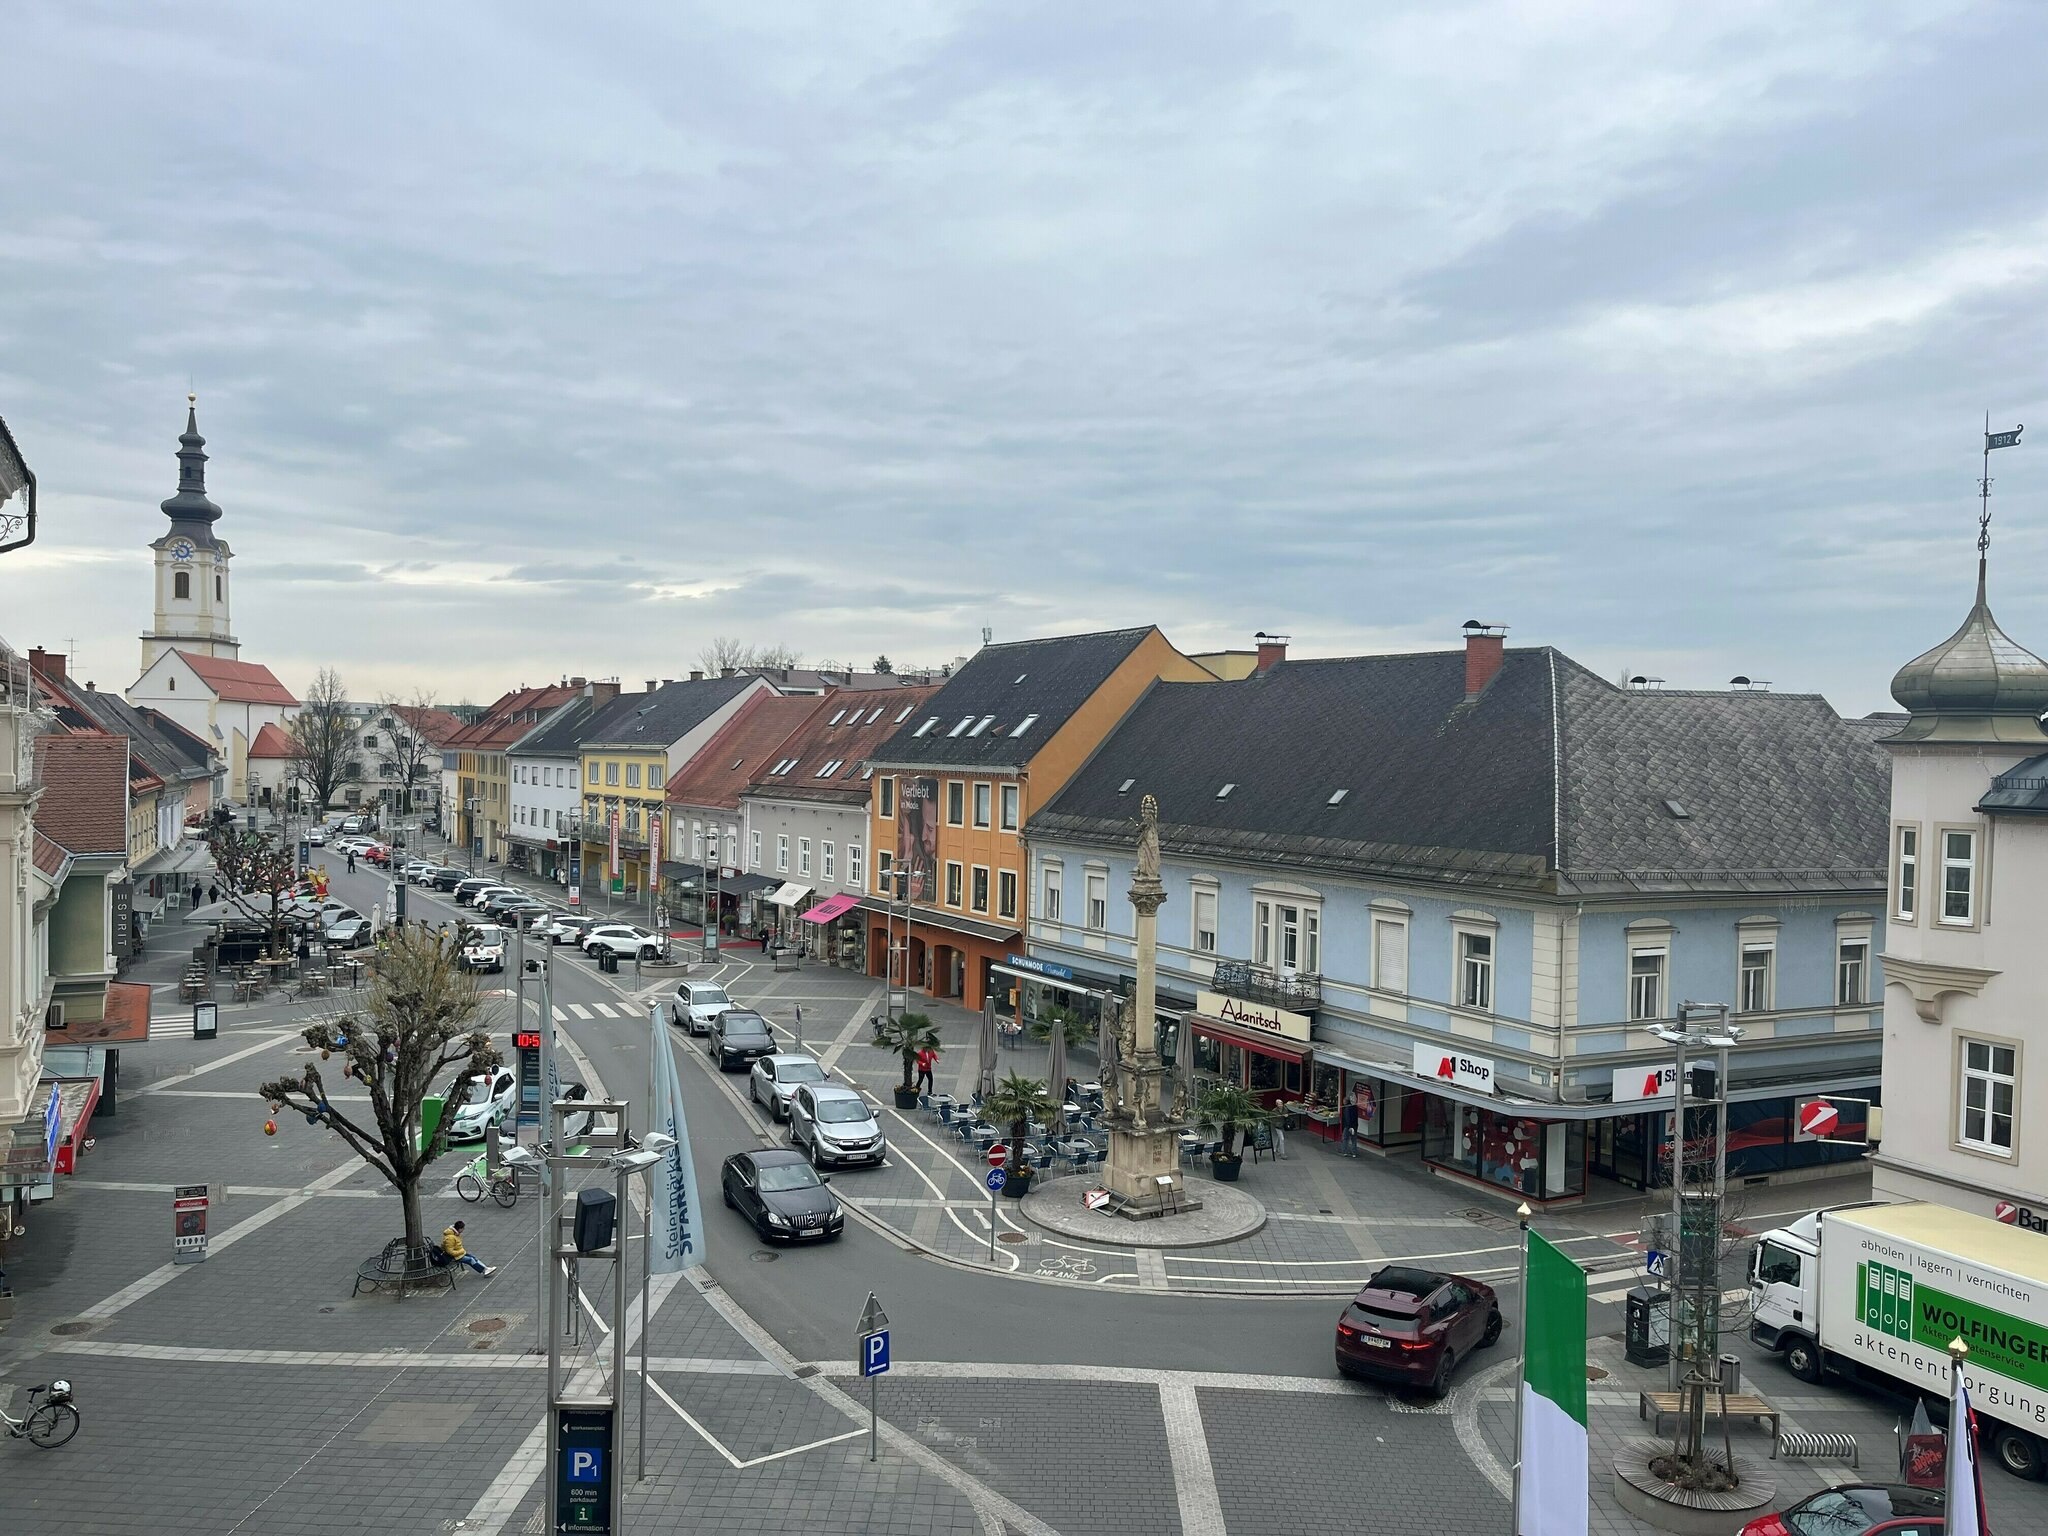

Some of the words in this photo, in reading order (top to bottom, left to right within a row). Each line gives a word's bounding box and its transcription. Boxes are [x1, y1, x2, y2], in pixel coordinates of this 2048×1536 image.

[1994, 434, 2012, 446] 1912
[901, 783, 930, 798] Verliebt
[117, 893, 127, 946] ESPRIT
[1221, 998, 1281, 1031] Adanitsch
[518, 1034, 540, 1047] 10:5
[1437, 1057, 1457, 1080] A1
[1460, 1058, 1489, 1080] Shop
[1643, 1070, 1662, 1097] A1
[665, 1117, 680, 1260] Steiermärkishe
[1034, 1269, 1080, 1280] ANFANG
[1861, 1239, 1905, 1261] abholen
[1917, 1256, 1953, 1277] lagern
[1966, 1273, 2030, 1302] vernichten
[870, 1336, 884, 1364] P
[1854, 1333, 2046, 1424] aktenentorgung
[584, 1488, 598, 1496] min
[567, 1522, 604, 1532] information
